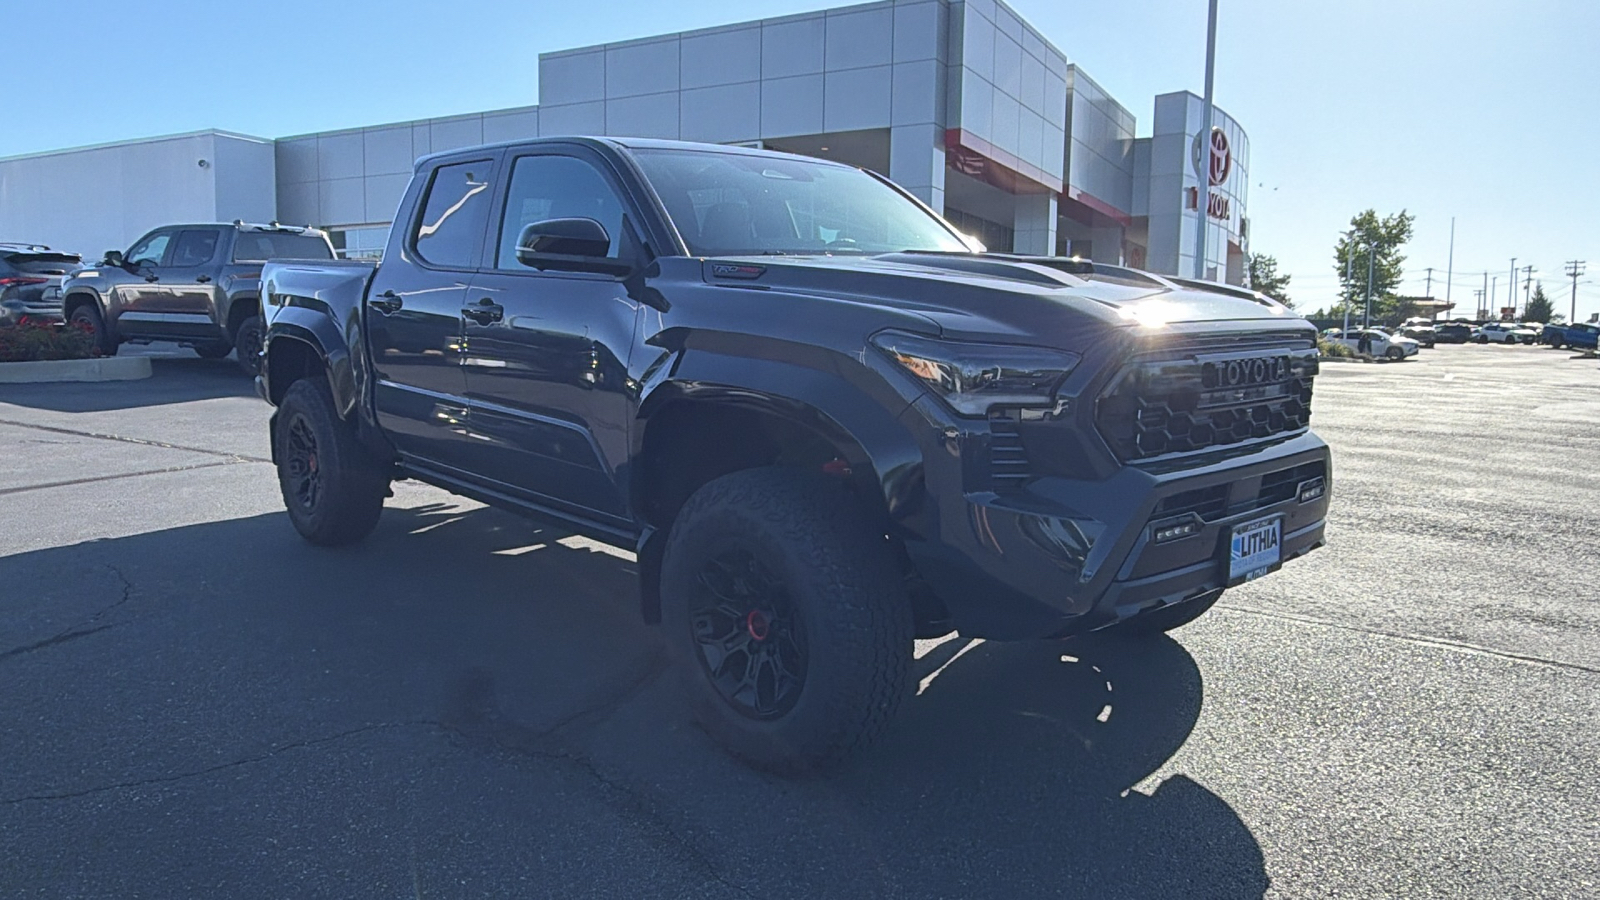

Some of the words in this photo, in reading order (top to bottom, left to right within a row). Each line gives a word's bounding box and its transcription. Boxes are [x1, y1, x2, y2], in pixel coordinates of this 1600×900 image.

[1190, 186, 1230, 220] TYOTA
[1216, 357, 1285, 386] TOYOTA
[1241, 526, 1278, 558] LITHIA
